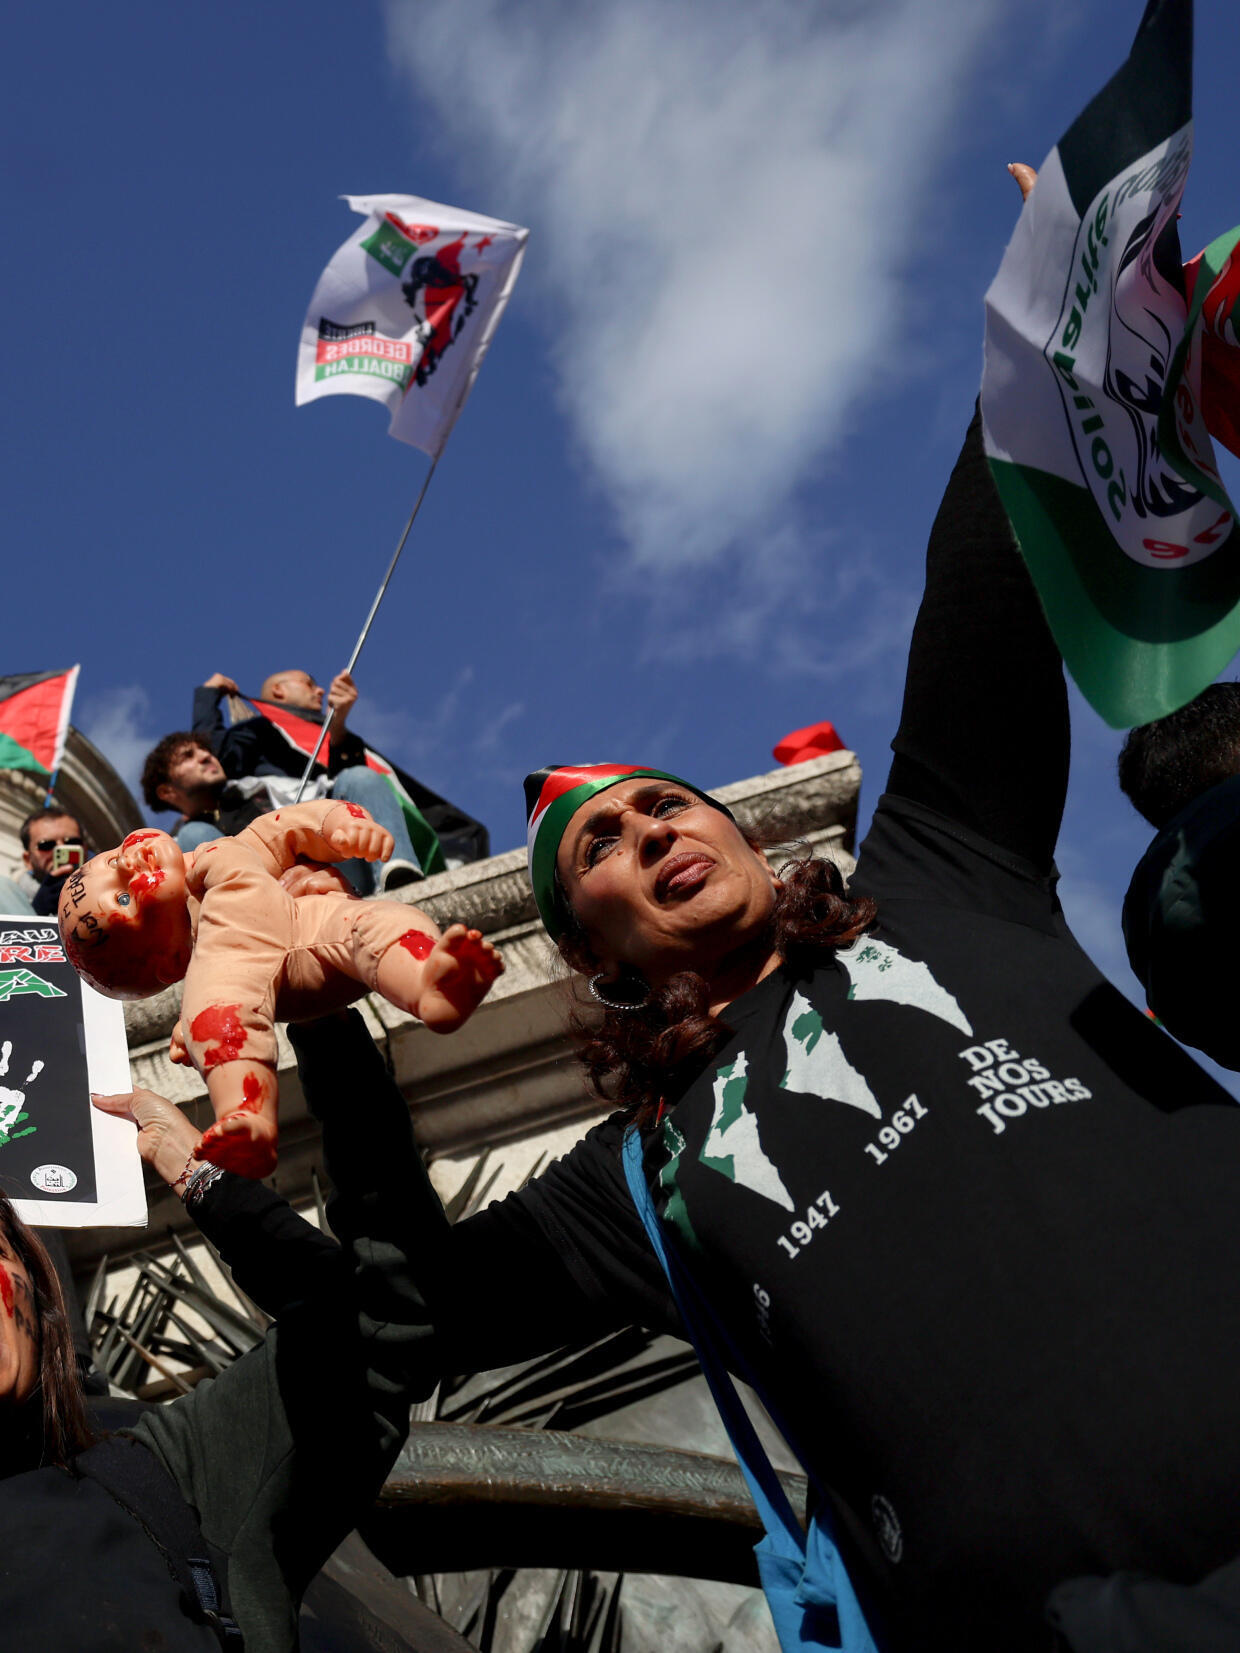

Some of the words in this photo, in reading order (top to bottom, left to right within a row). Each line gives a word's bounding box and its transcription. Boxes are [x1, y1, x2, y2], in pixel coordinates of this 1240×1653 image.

[959, 1038, 1020, 1072] DE
[967, 1058, 1051, 1099] NOS
[864, 1093, 928, 1165] 1967
[976, 1077, 1092, 1135] JOURS
[777, 1190, 840, 1259] 1947
